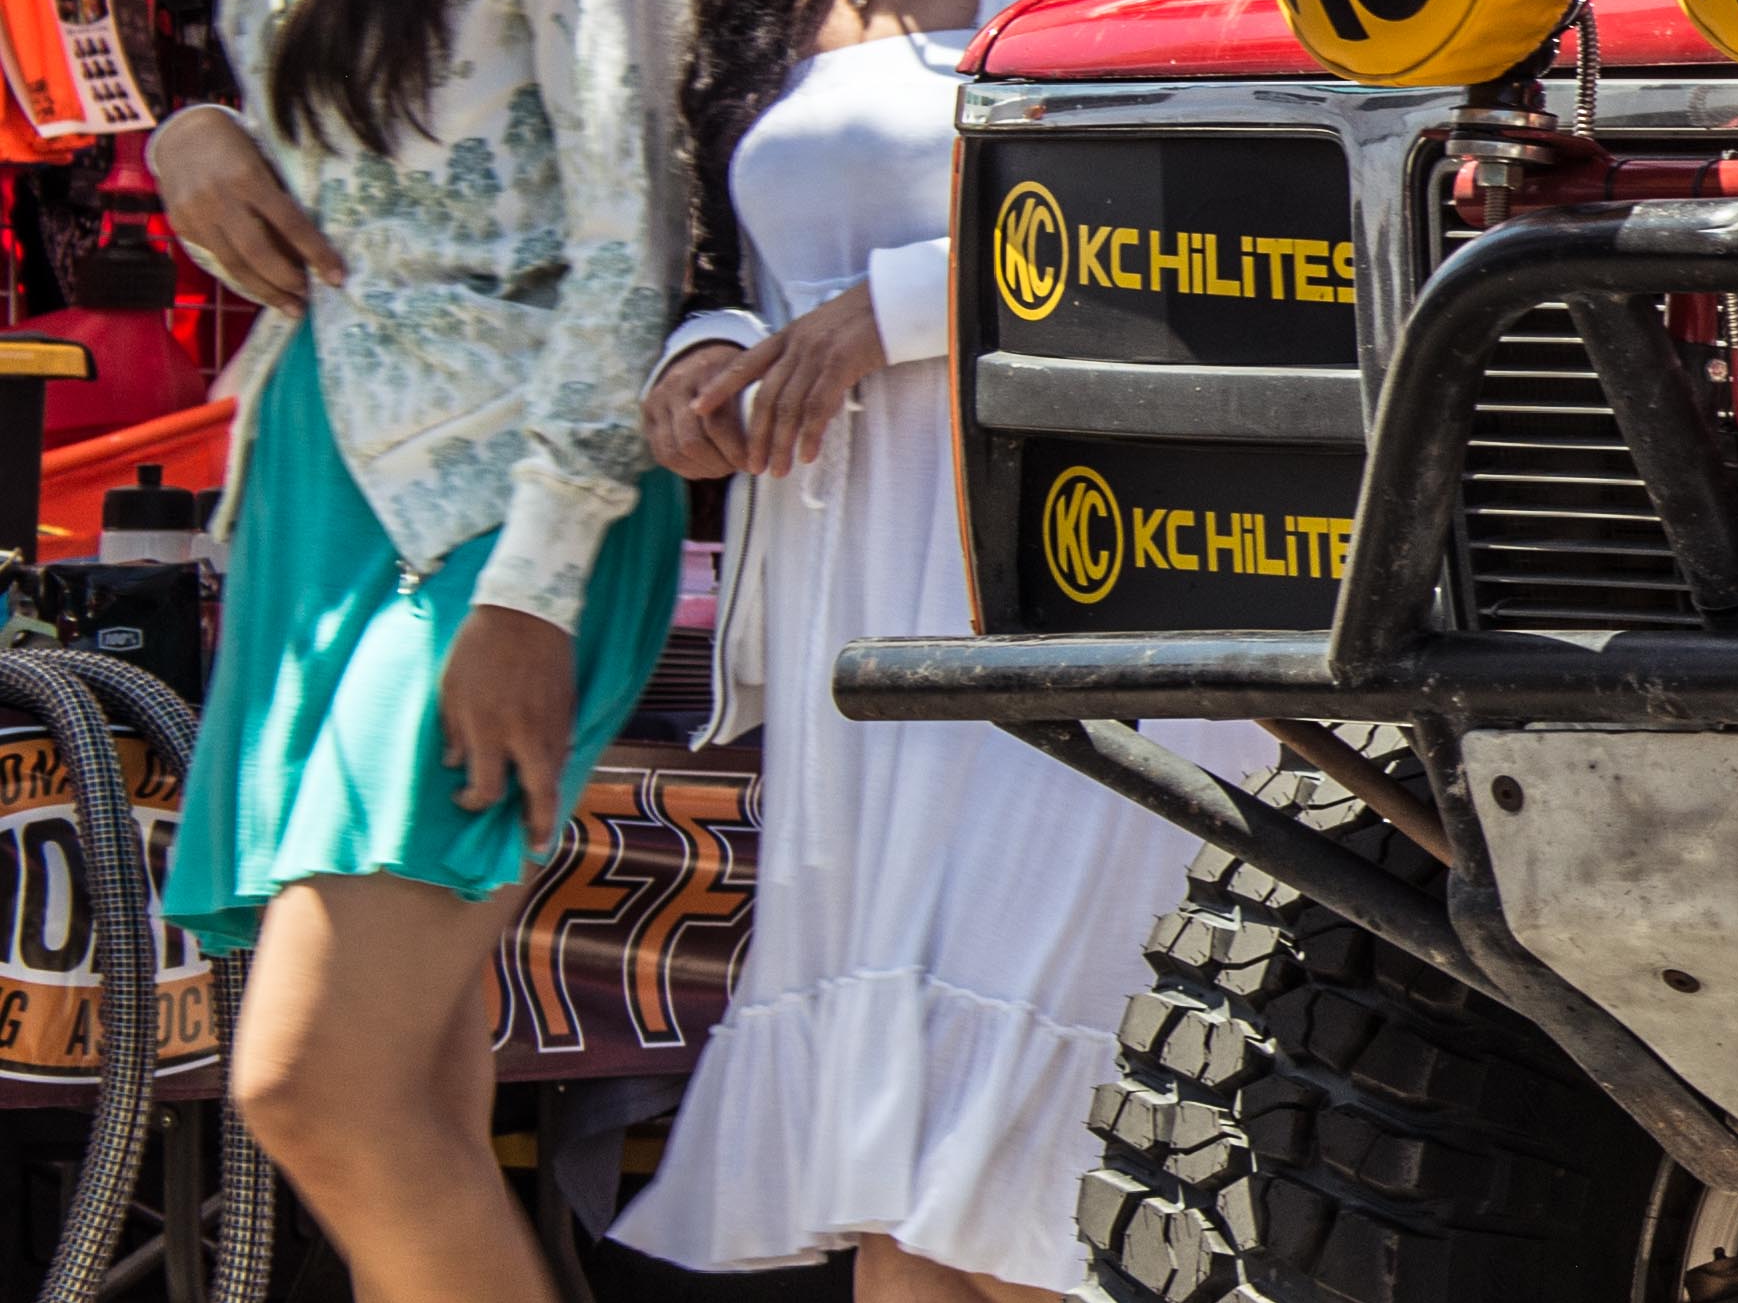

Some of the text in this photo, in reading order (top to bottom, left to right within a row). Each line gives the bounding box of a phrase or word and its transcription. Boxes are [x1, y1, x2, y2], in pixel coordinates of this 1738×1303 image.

[1006, 198, 1055, 304] KC
[1079, 224, 1142, 291] KC
[1056, 482, 1353, 586] KC KC HiLiTE
